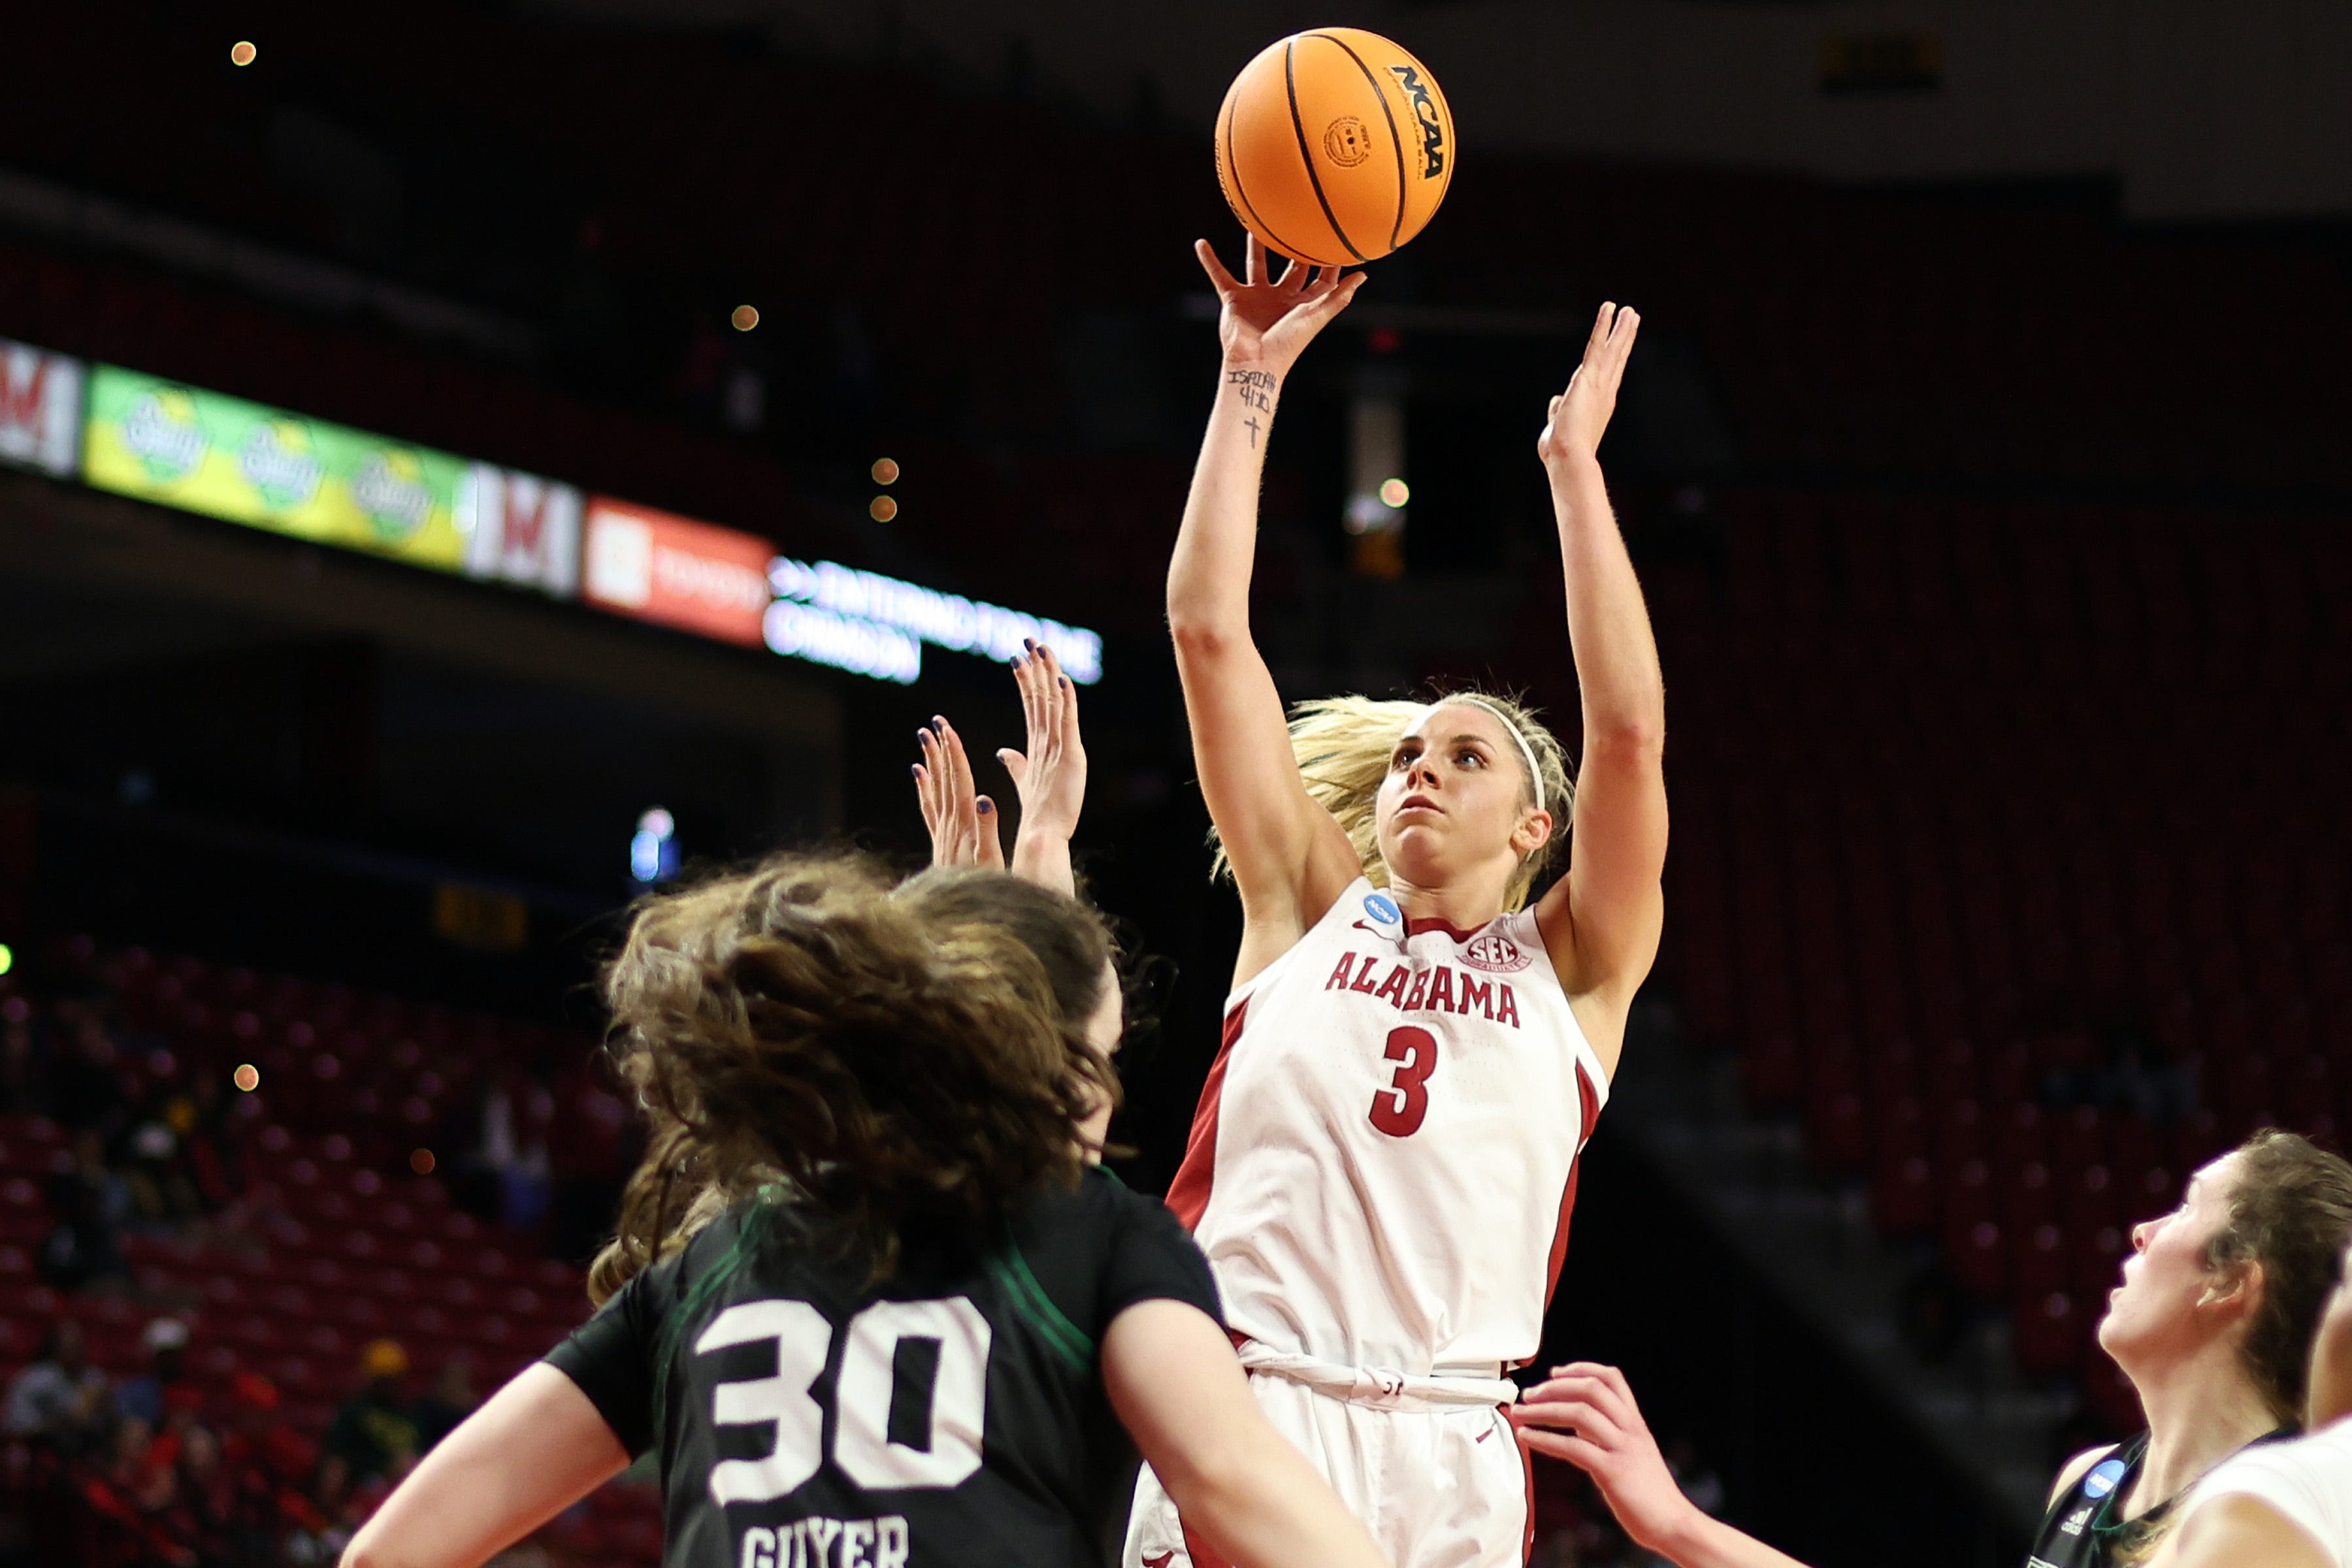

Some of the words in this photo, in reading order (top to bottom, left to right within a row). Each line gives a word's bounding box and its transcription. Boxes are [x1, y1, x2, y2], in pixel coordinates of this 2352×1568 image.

[1391, 66, 1444, 179] NCAA
[1325, 952, 1520, 1029] ALABAMA
[1470, 936, 1516, 964] SEC
[1368, 1026, 1437, 1137] 3
[694, 1296, 992, 1509] 30
[742, 1514, 909, 1568] GUYER
